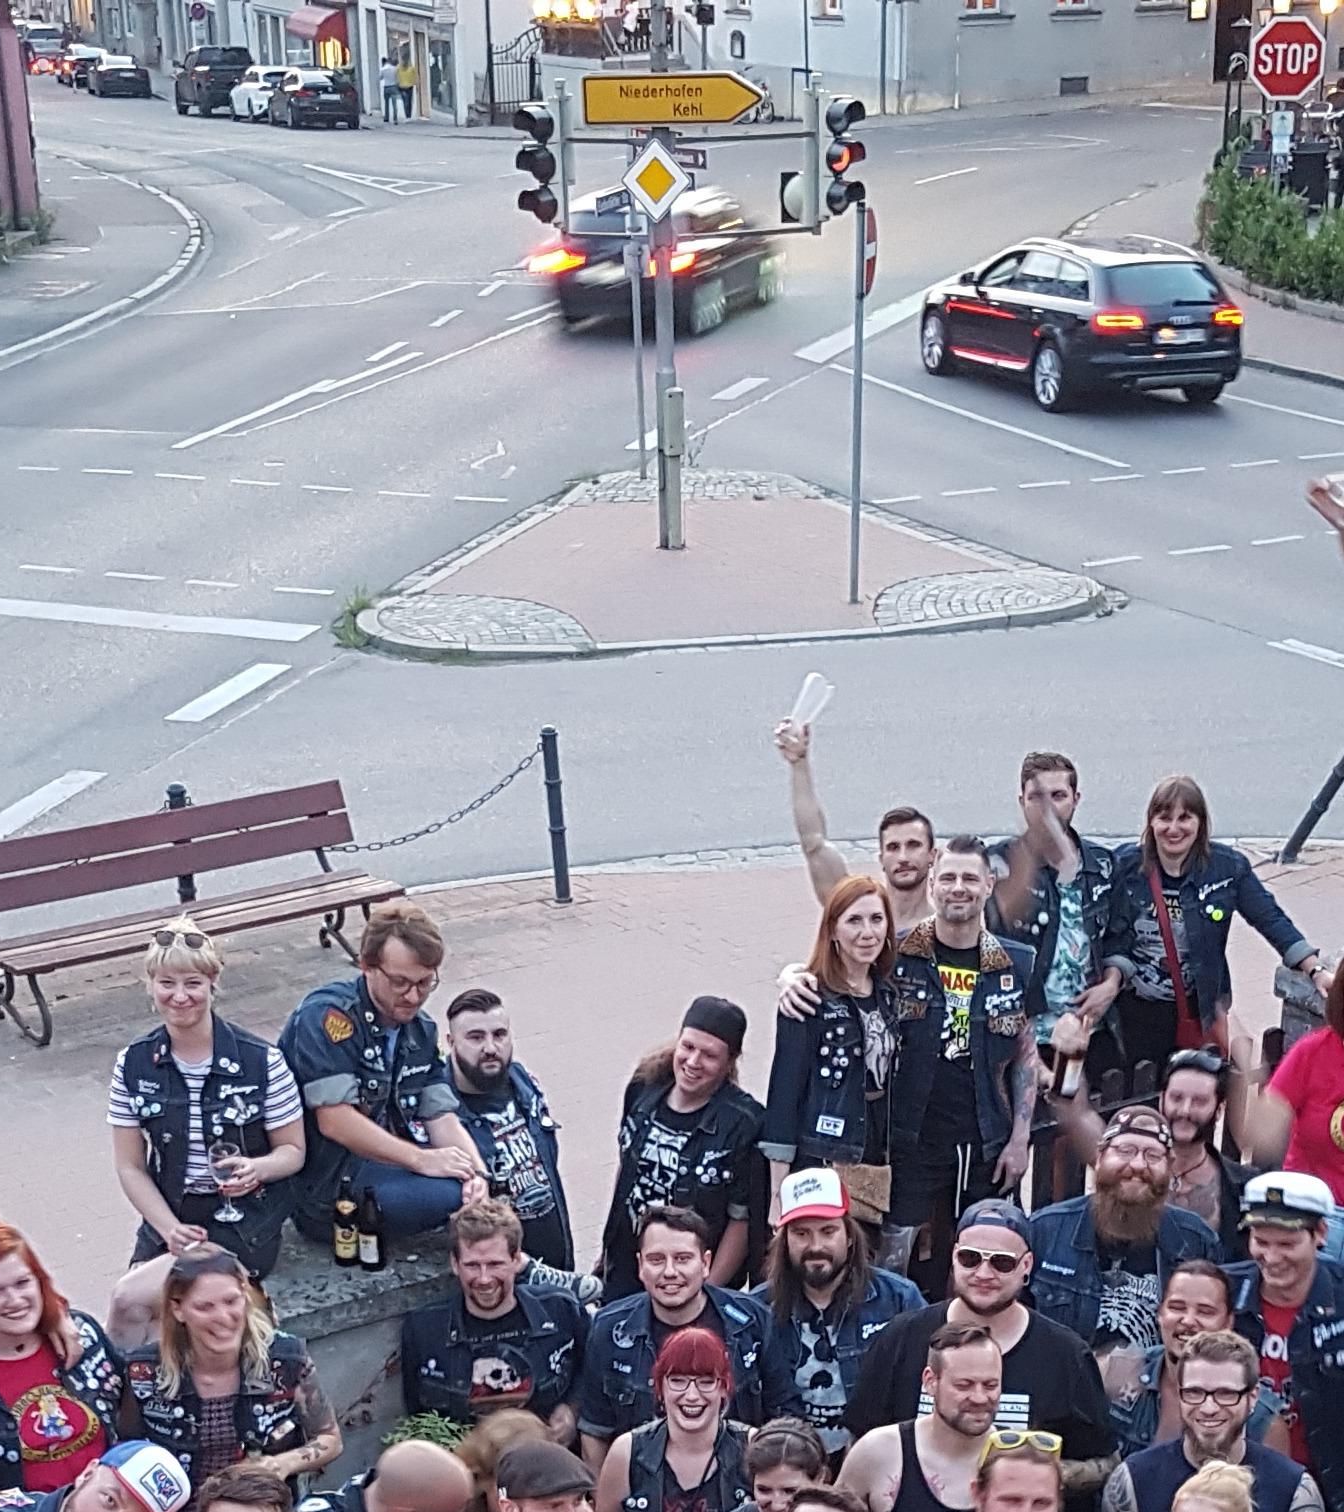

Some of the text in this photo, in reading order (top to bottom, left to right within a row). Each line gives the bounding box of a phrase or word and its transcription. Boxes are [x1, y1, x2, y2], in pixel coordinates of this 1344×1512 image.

[1258, 42, 1318, 75] STOP
[619, 84, 703, 99] Niederhofen
[673, 103, 703, 117] Kehl
[940, 971, 975, 991] NAG
